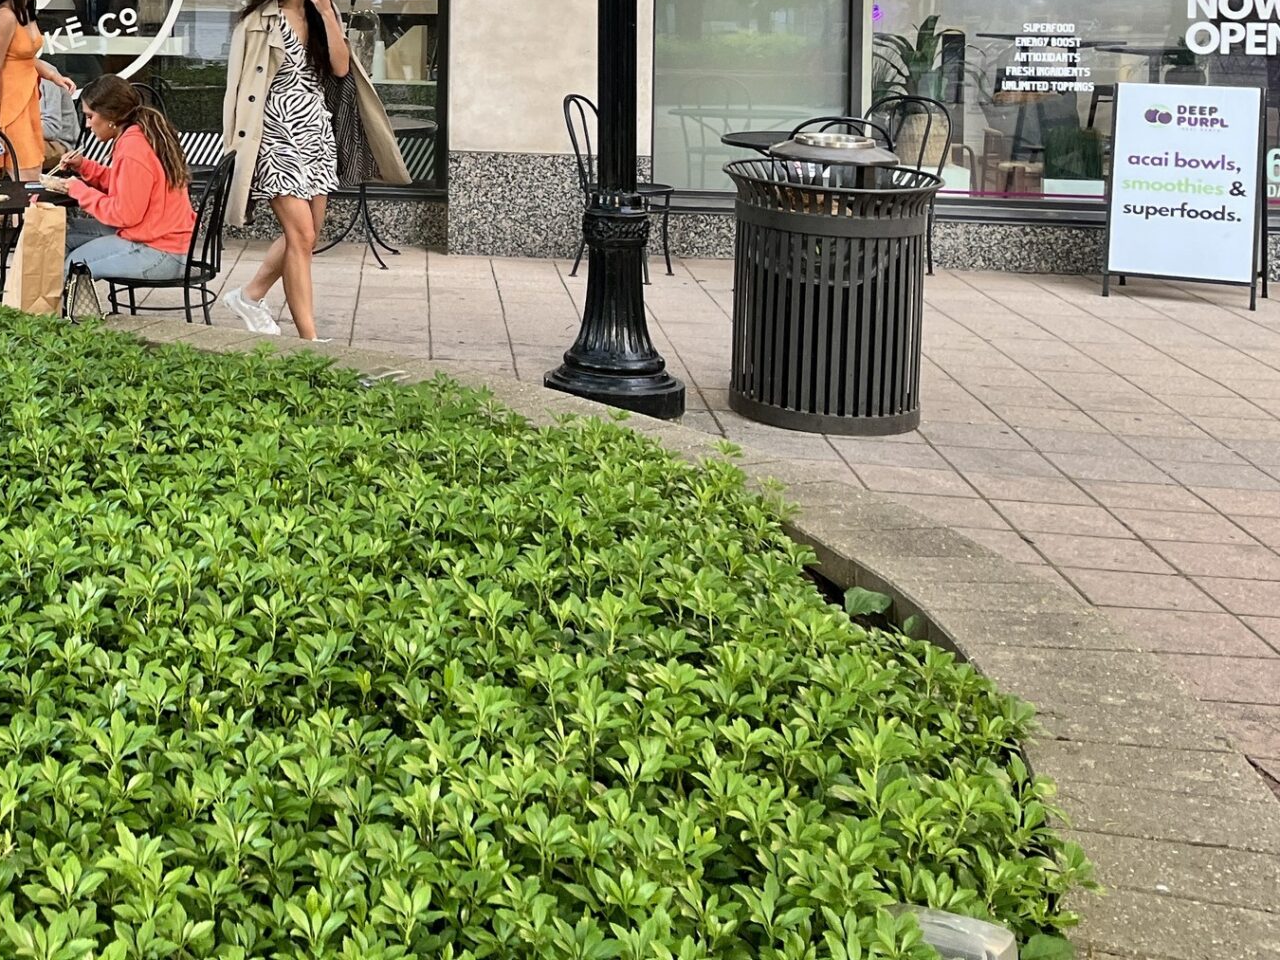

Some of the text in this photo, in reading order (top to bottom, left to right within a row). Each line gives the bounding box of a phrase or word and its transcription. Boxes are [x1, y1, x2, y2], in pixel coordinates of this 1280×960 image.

[1022, 23, 1075, 33] SUPERFOOD
[1015, 37, 1082, 47] ENERGY BOOST
[1014, 52, 1081, 63] ANTIOXIDANTS
[1005, 66, 1035, 76] FRESH
[1001, 80, 1095, 92] UNLIMITED TOPPINGS
[1177, 105, 1218, 116] DEEP
[1176, 116, 1229, 128] PURPL
[1127, 151, 1242, 174] acai bowls,
[1122, 177, 1247, 197] smoothies &
[1122, 202, 1242, 222] superfoods.
